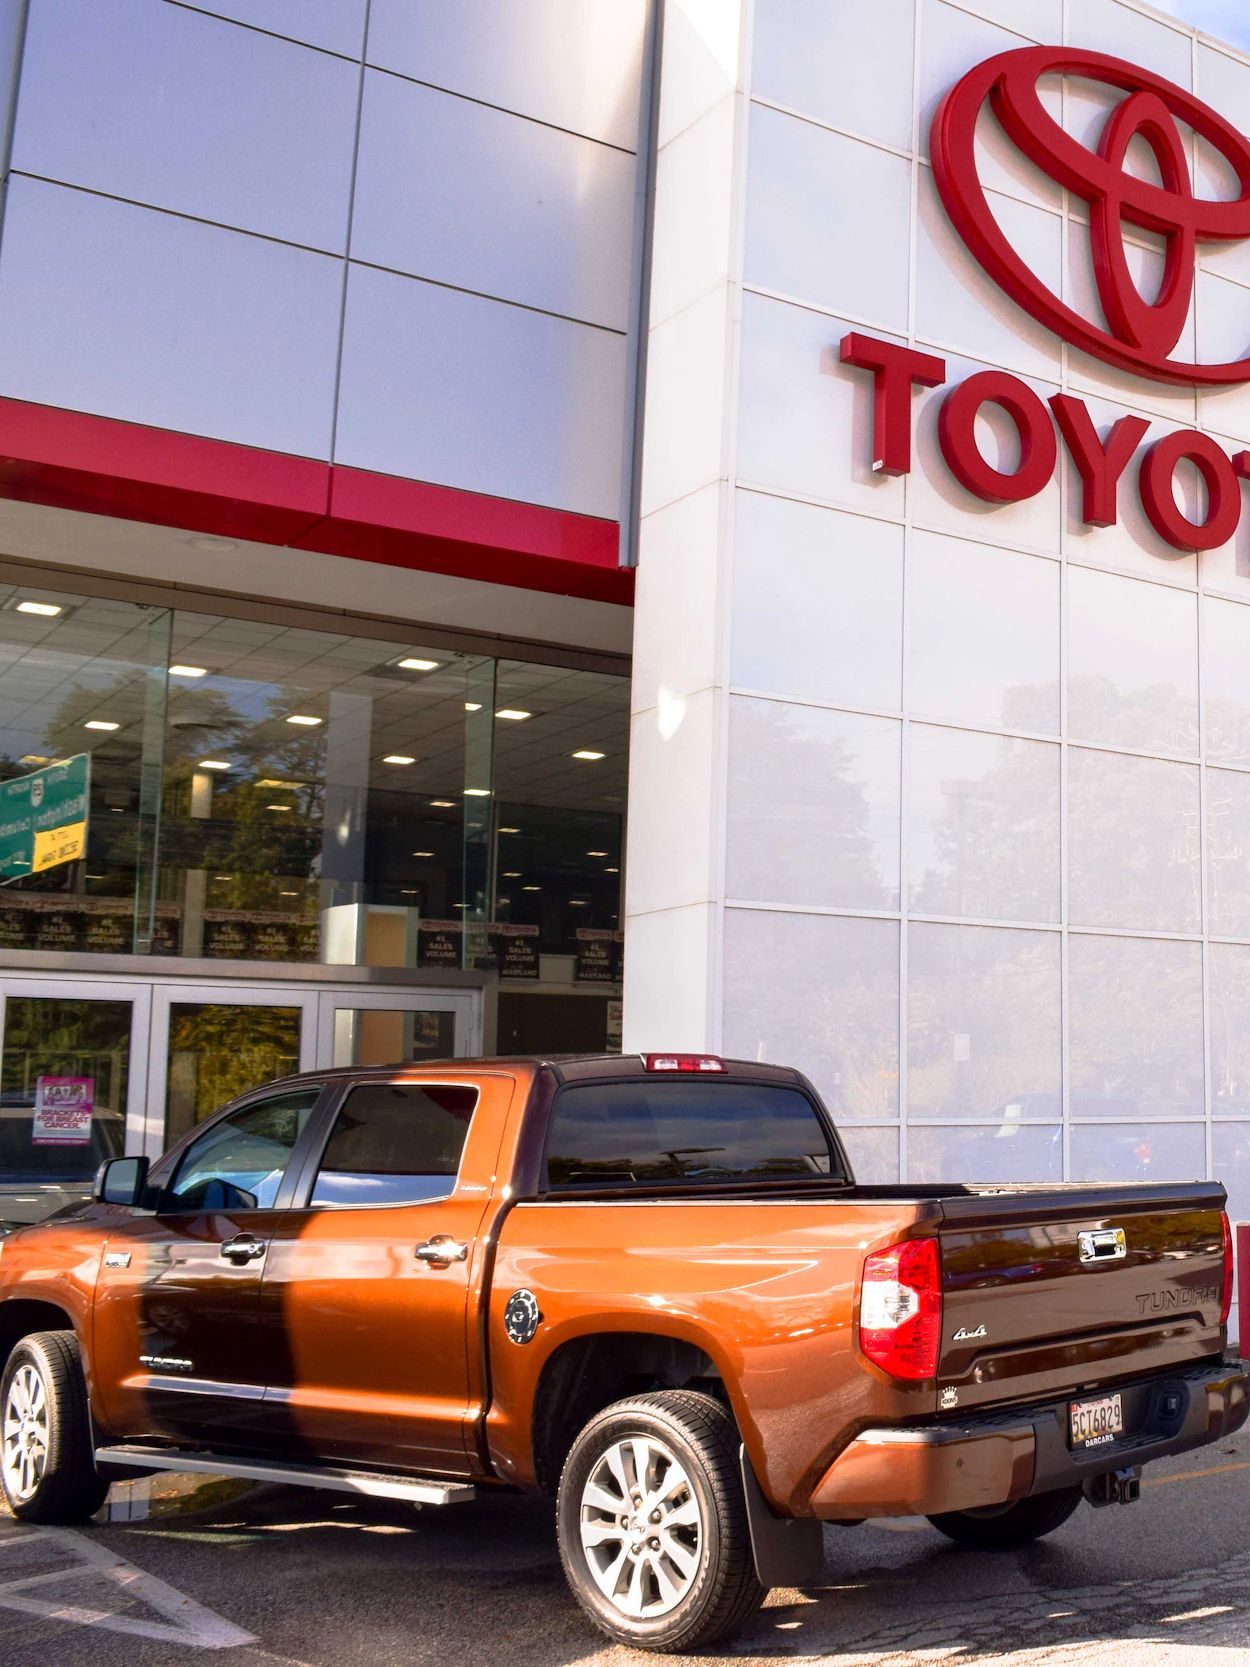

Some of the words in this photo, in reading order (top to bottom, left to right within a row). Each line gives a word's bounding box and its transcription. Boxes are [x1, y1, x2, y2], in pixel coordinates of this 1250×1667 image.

[429, 942, 453, 951] SALES
[508, 946, 532, 955] SALES
[425, 950, 457, 959] VOLUME
[505, 954, 535, 963] VOLUME
[581, 958, 609, 966] VOLUME
[1135, 1286, 1219, 1315] TUNDRA
[1072, 1404, 1122, 1438] 5CT6829
[1084, 1433, 1115, 1448] DARCARS
